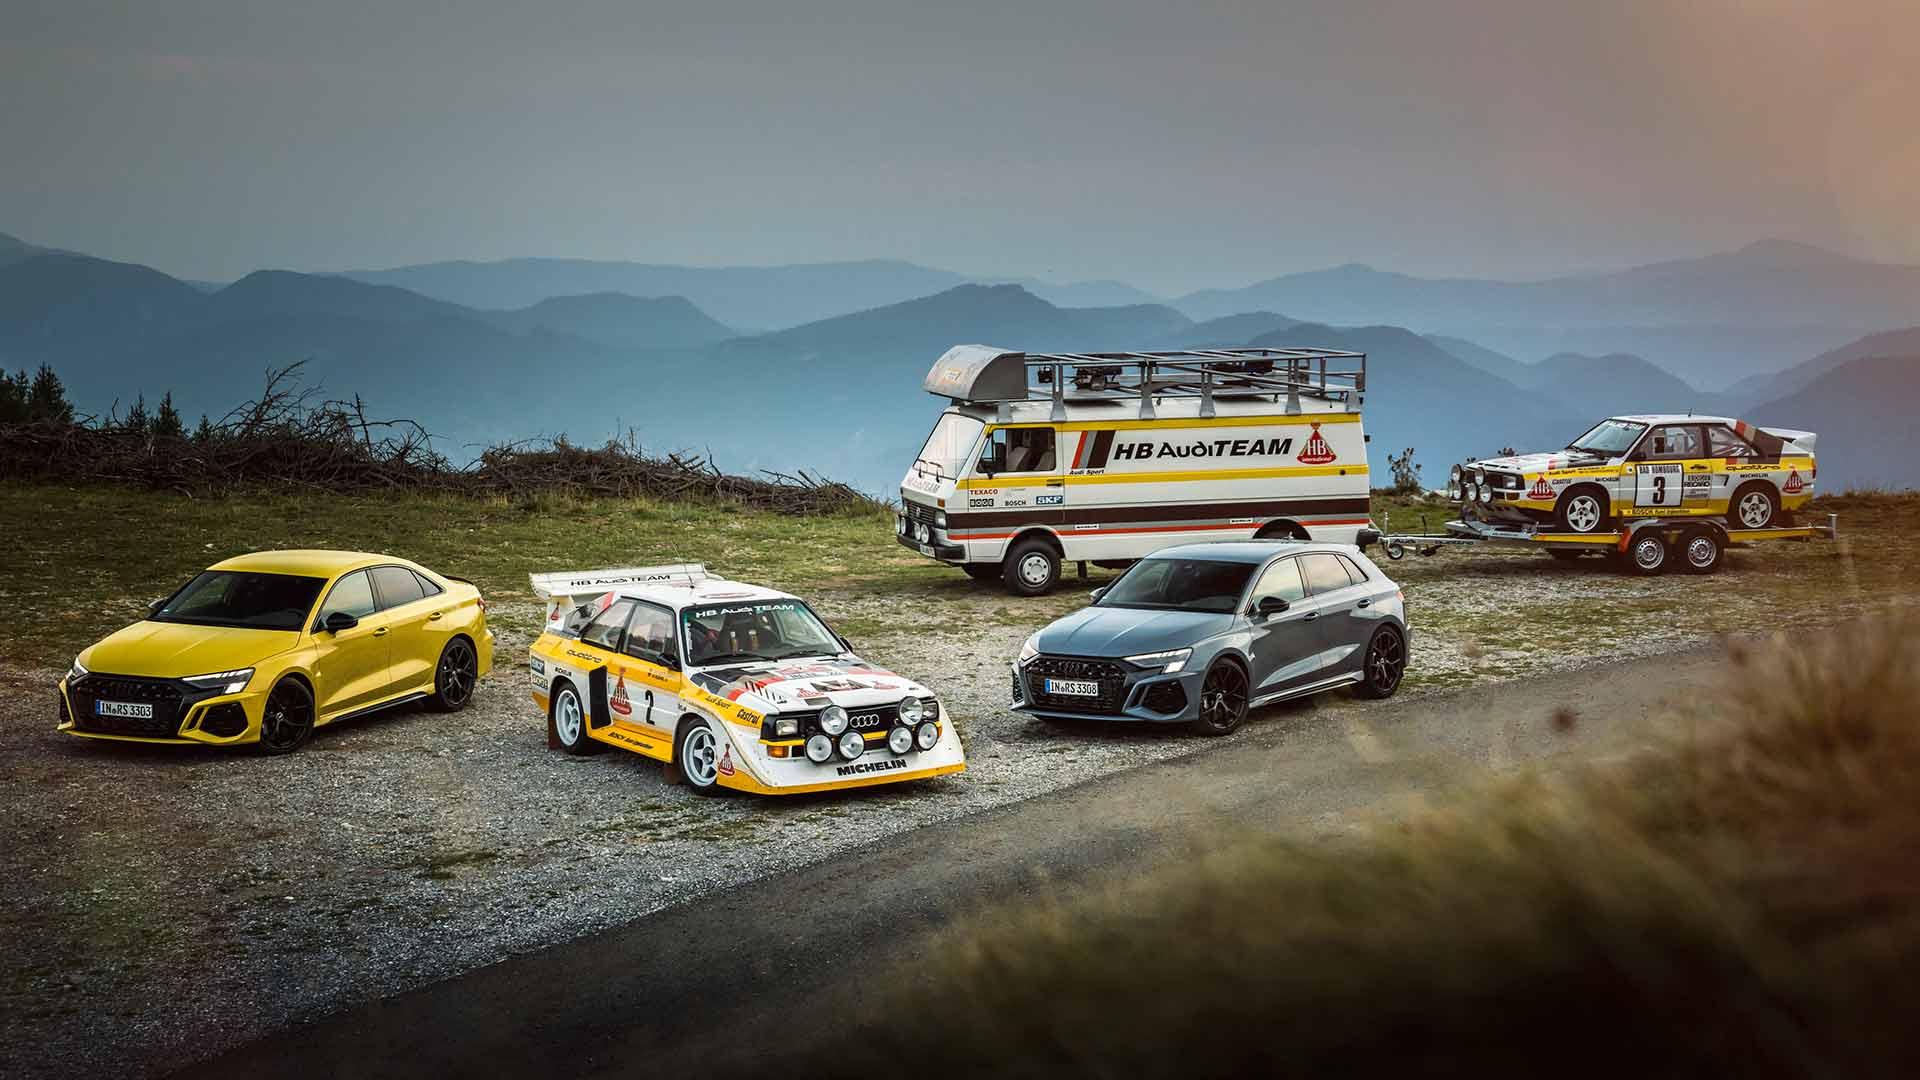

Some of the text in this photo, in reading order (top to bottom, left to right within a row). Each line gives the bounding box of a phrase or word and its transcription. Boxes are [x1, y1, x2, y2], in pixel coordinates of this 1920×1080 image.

[1114, 443, 1154, 460] HB
[1307, 439, 1327, 456] HB
[1725, 464, 1781, 472] quattro
[1652, 476, 1666, 504] 3
[1037, 496, 1062, 504] SKF
[695, 609, 718, 618] HB
[566, 649, 602, 664] quattro
[1051, 681, 1097, 695] IN RS 3308
[101, 702, 151, 717] IN RS 3303
[645, 689, 656, 726] 2
[715, 697, 731, 709] Sport
[736, 708, 760, 725] Castrol
[836, 758, 907, 776] MICHELIN
